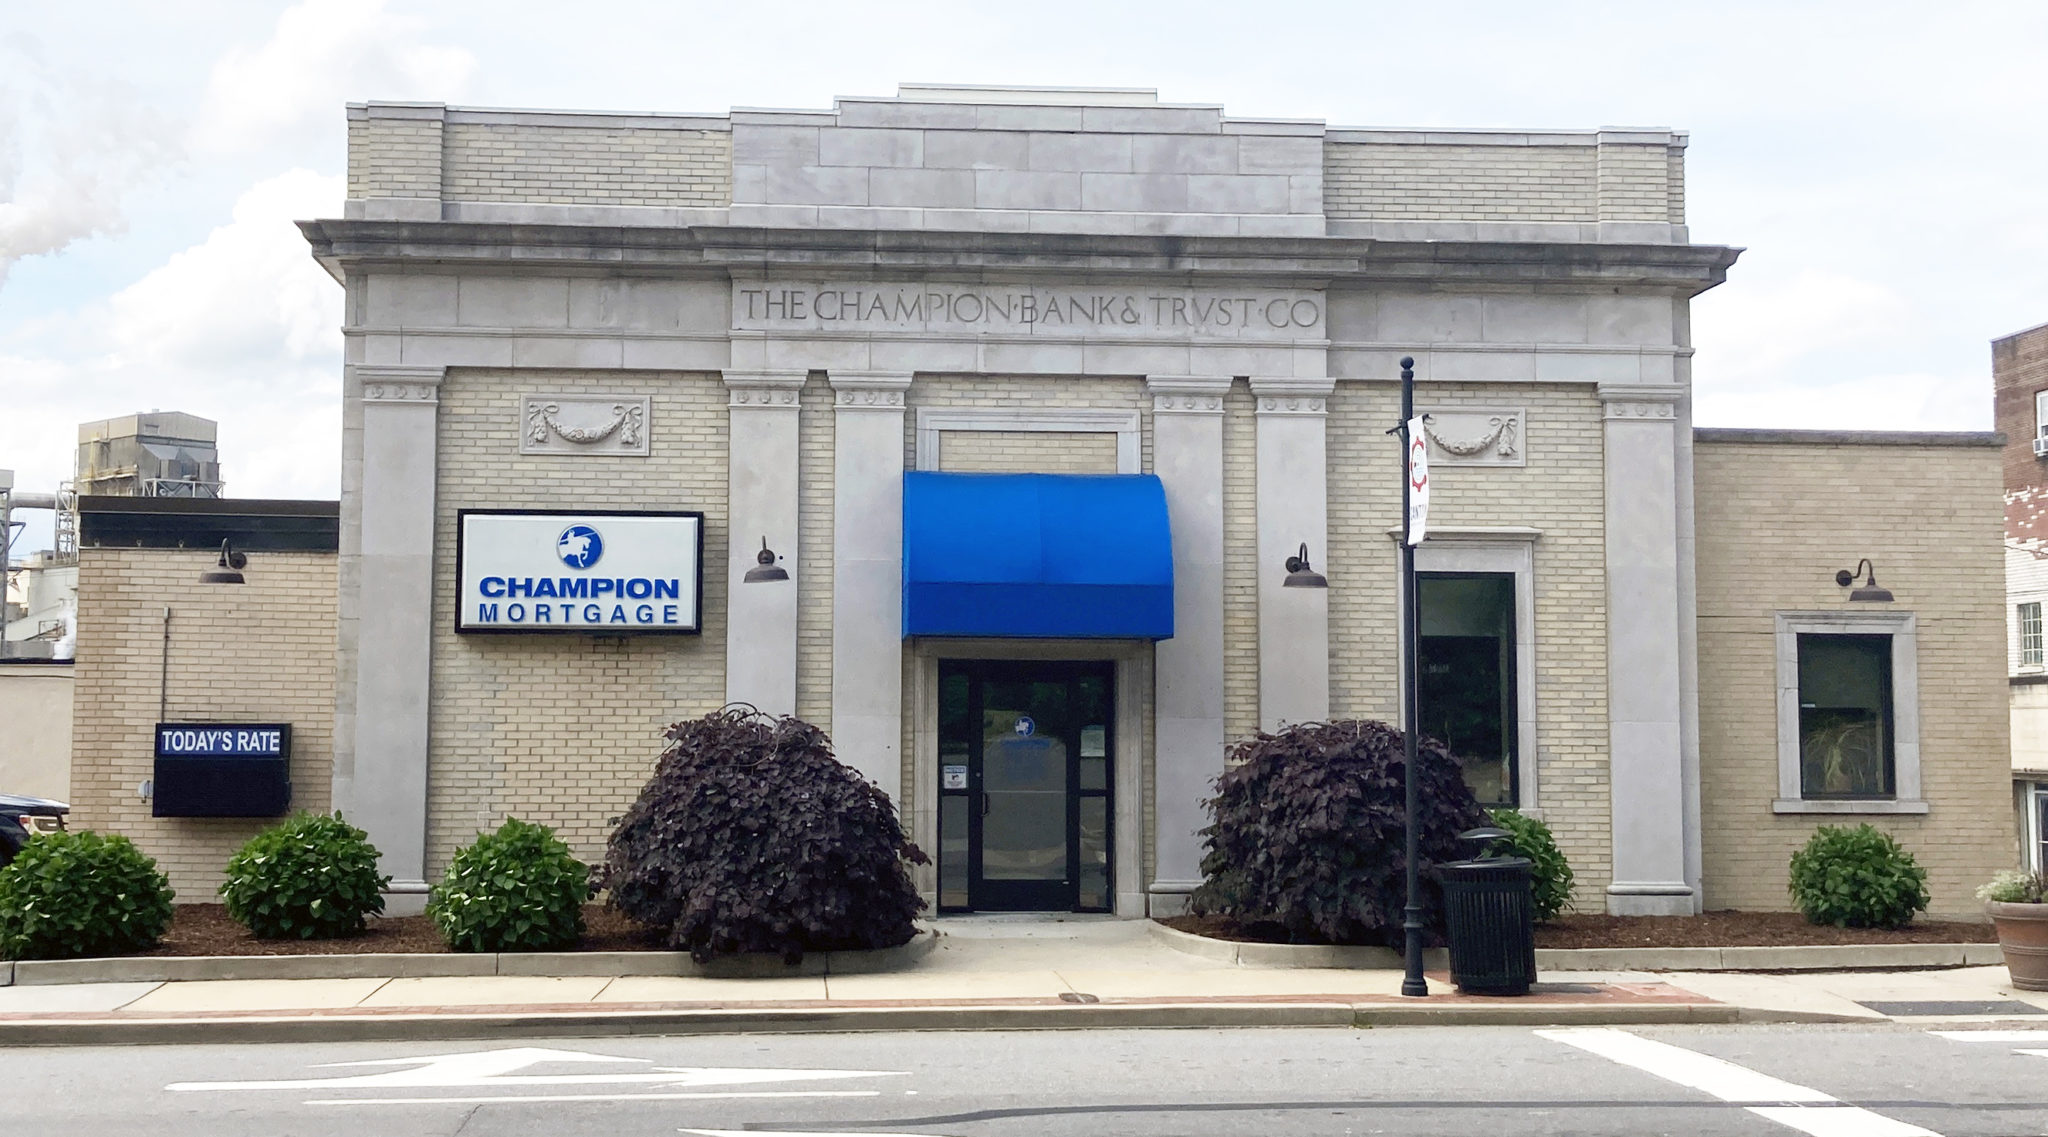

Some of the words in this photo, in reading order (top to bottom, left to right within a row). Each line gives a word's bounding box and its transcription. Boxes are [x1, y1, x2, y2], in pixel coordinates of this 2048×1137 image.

[741, 290, 807, 320] THE
[1121, 296, 1141, 325] &
[1266, 299, 1319, 328] CO
[479, 576, 679, 599] CHAMPION
[479, 603, 678, 623] MORTGAGE
[162, 731, 233, 751] TODAY'S
[237, 731, 280, 751] RATE
